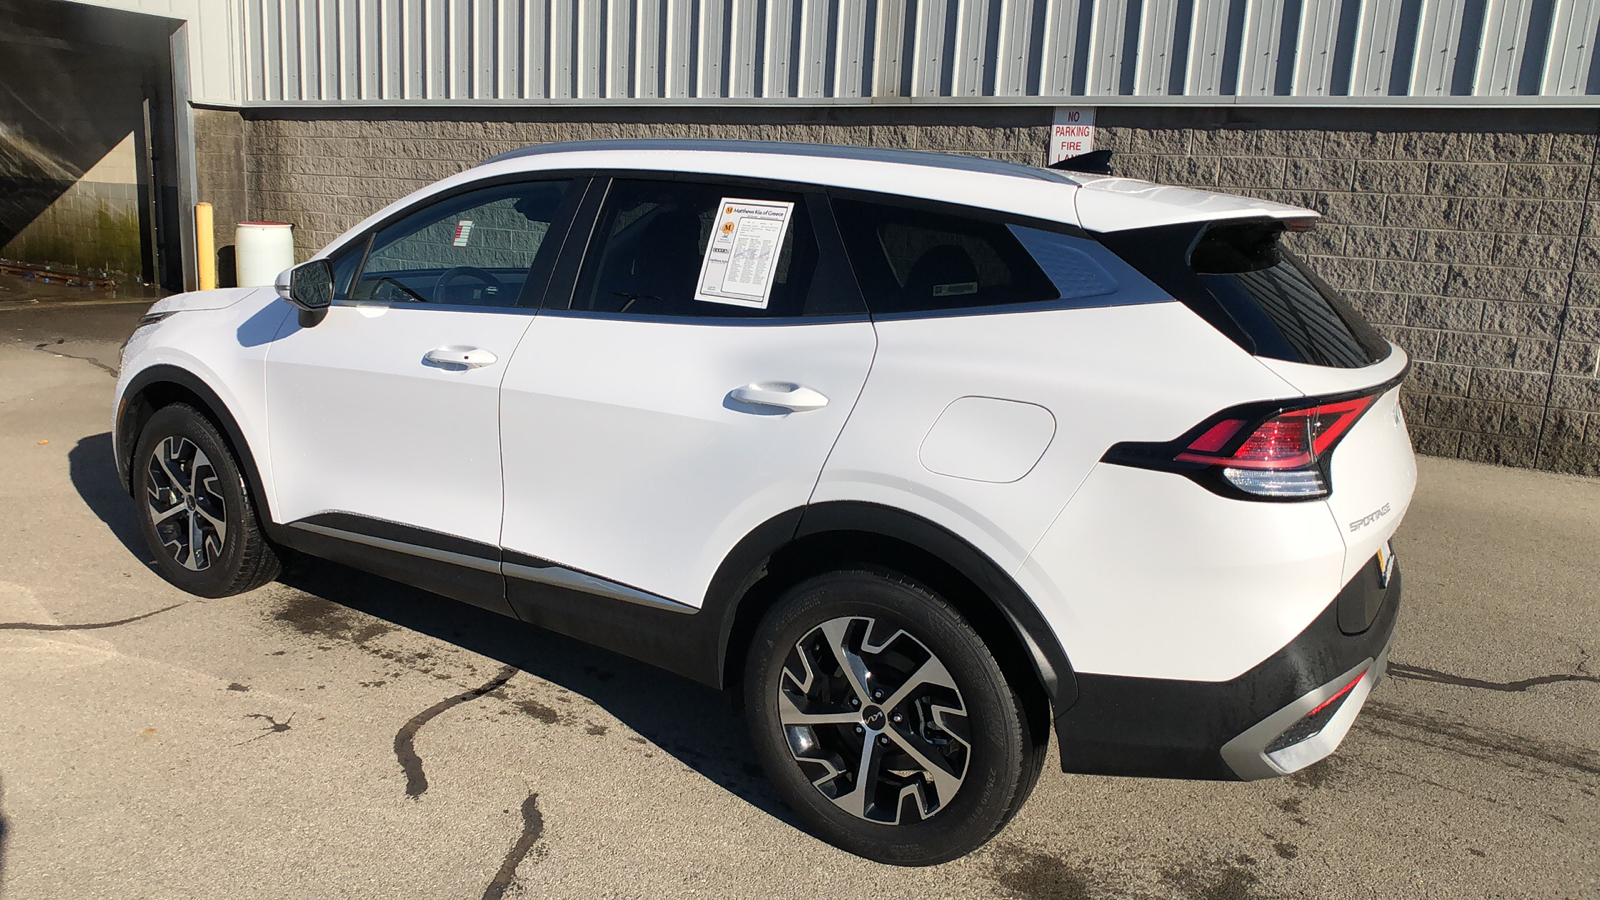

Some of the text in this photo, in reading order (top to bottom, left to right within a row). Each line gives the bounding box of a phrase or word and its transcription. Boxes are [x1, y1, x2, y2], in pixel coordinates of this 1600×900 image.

[1068, 111, 1080, 122] NO
[1055, 126, 1090, 137] PARKING
[1061, 142, 1082, 150] FIRE
[1057, 153, 1079, 162] LA
[1349, 502, 1391, 532] SPORTAGE
